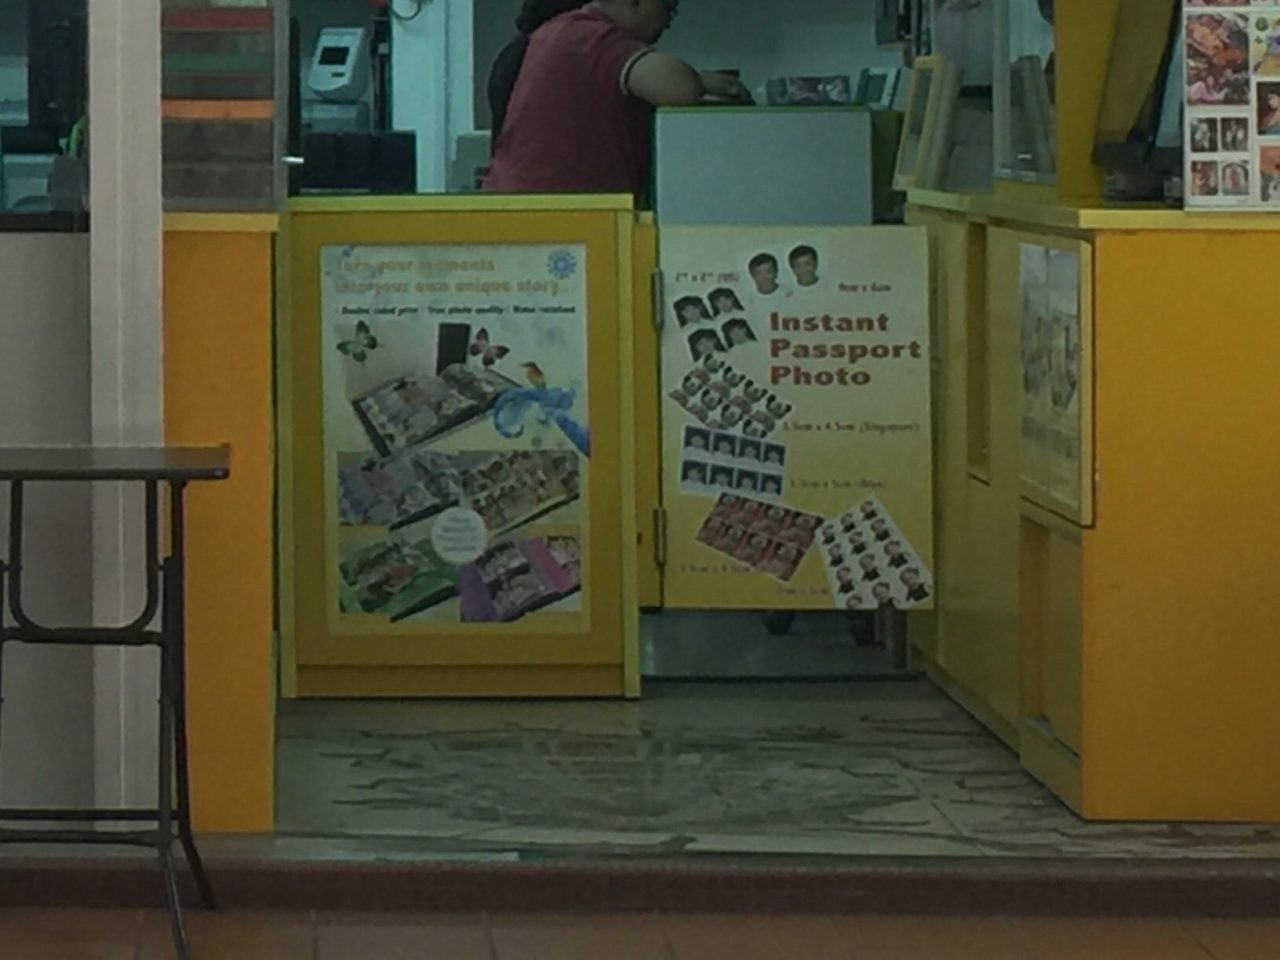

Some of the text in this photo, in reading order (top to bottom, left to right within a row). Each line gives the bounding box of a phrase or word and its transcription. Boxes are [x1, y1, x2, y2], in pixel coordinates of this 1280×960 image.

[768, 311, 890, 333] Instant
[768, 338, 923, 364] Passport
[768, 365, 873, 387] Photo
